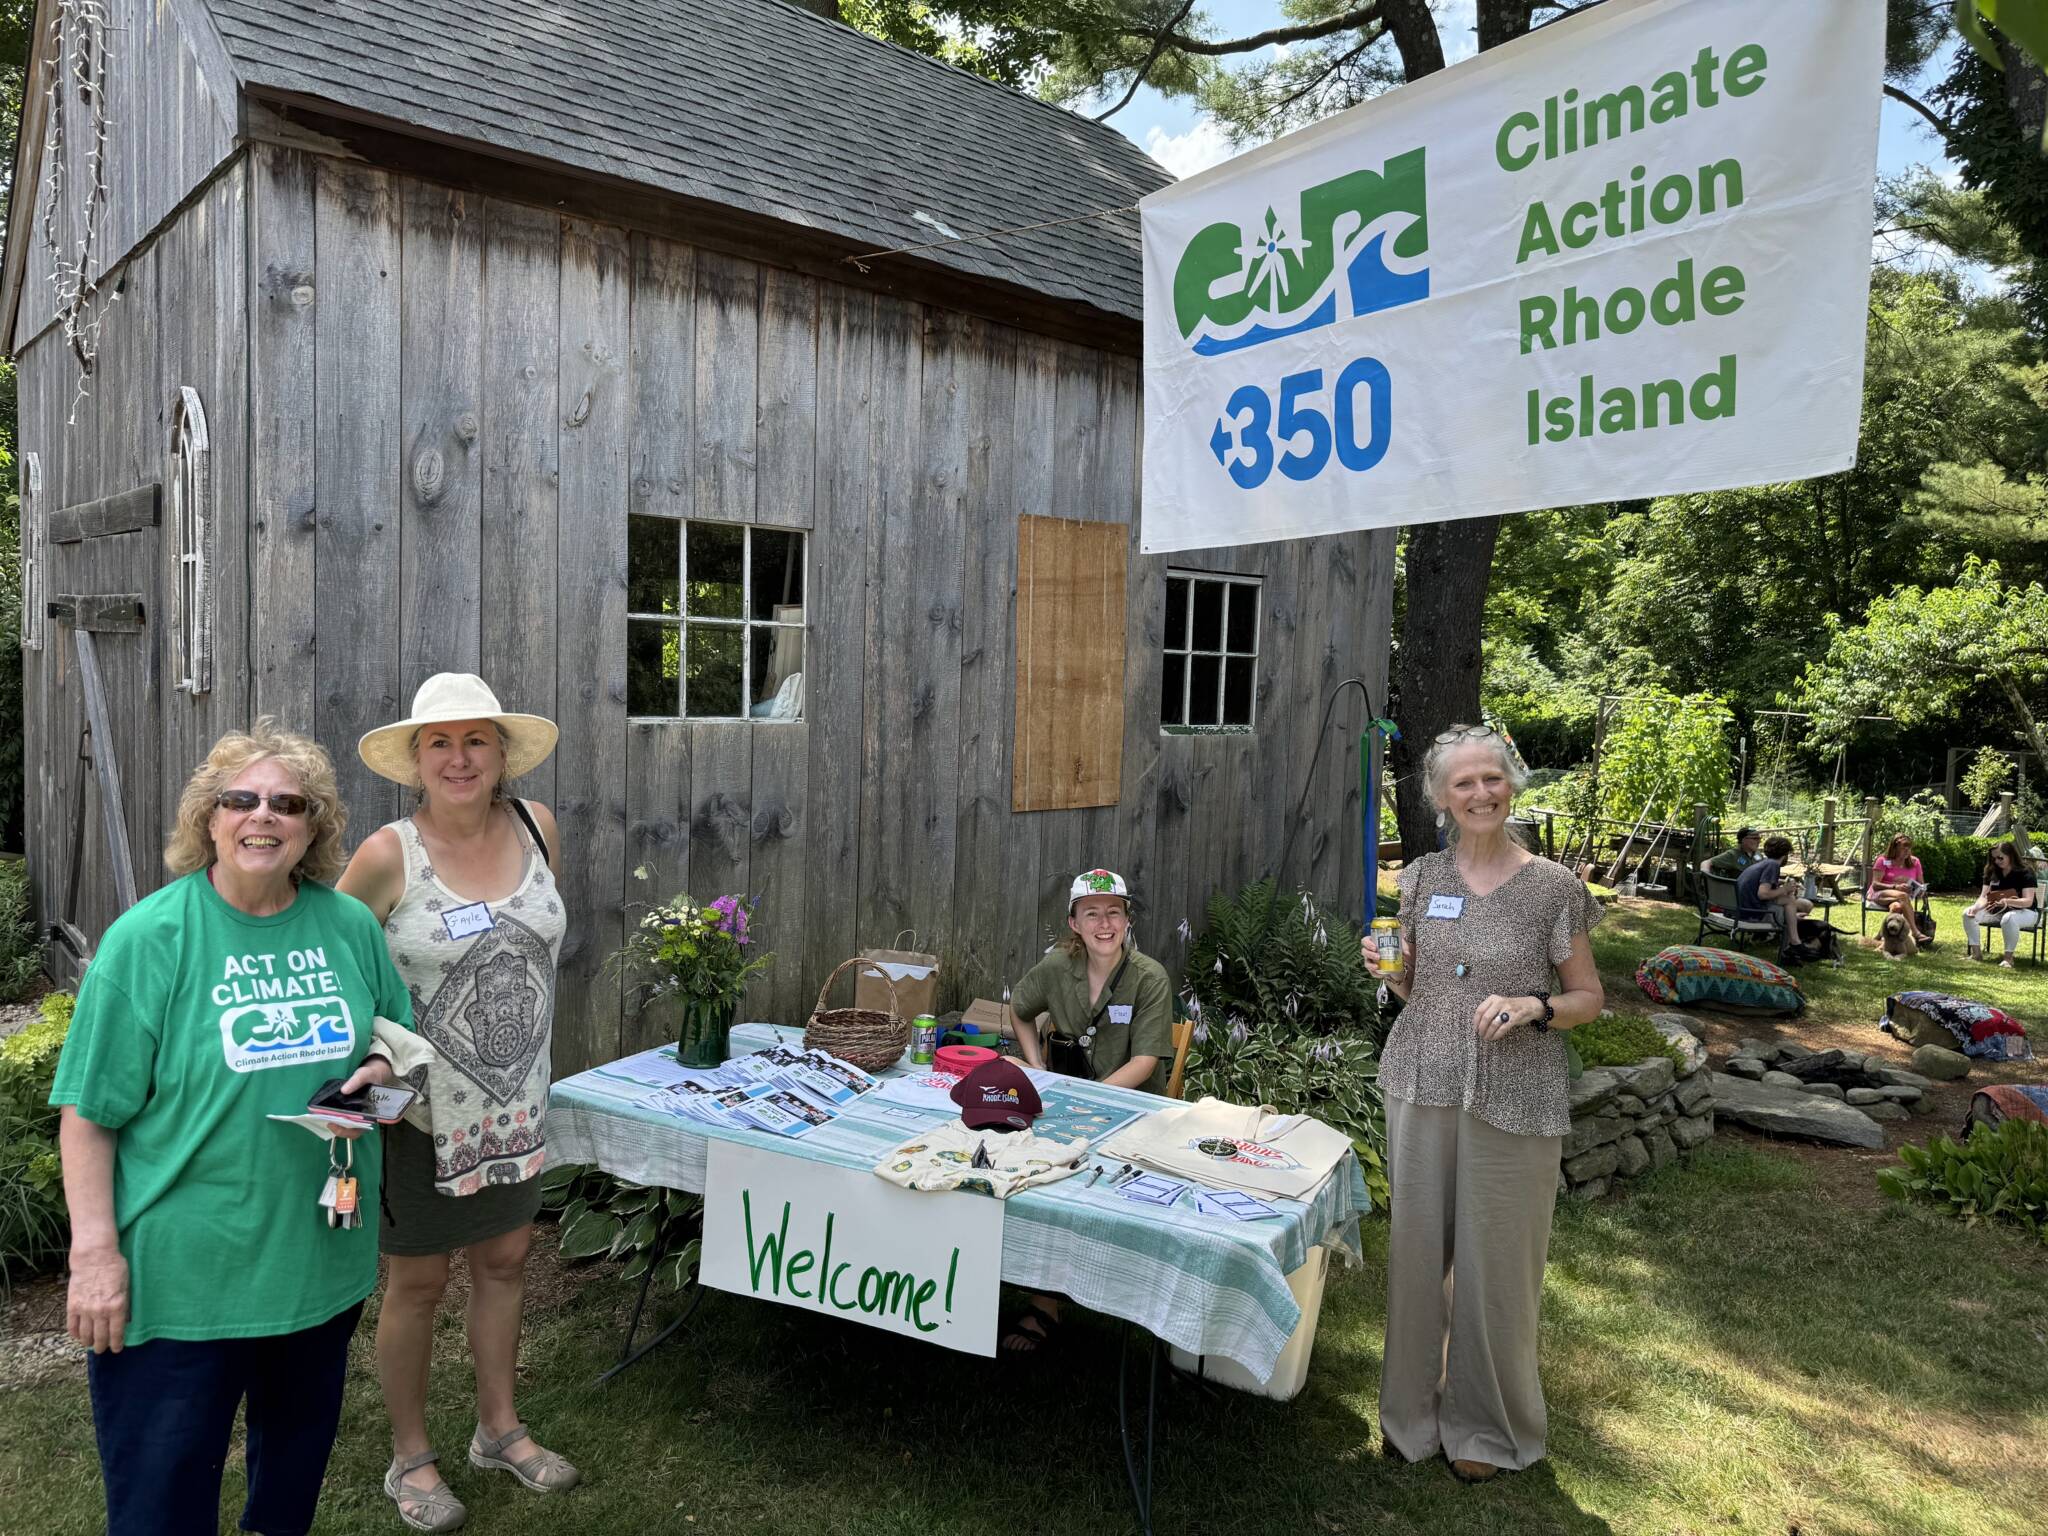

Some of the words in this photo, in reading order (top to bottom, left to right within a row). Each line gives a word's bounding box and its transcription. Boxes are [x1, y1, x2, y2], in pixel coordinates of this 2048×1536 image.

[1496, 43, 1767, 172] Climate
[1516, 157, 1744, 264] Action
[1519, 258, 1746, 355] Rhode
[1223, 357, 1392, 490] 350
[1527, 355, 1737, 446] Island
[224, 954, 276, 980] ACT
[288, 947, 327, 972] ON
[1379, 936, 1399, 947] POLAR
[211, 971, 343, 1006] CLIMATE!
[235, 1055, 269, 1068] Climate
[271, 1051, 298, 1061] Action
[299, 1049, 326, 1058] Rhode
[327, 1044, 351, 1054] Island
[982, 1094, 1002, 1102] RHODE
[742, 1188, 959, 1332] Welcome!
